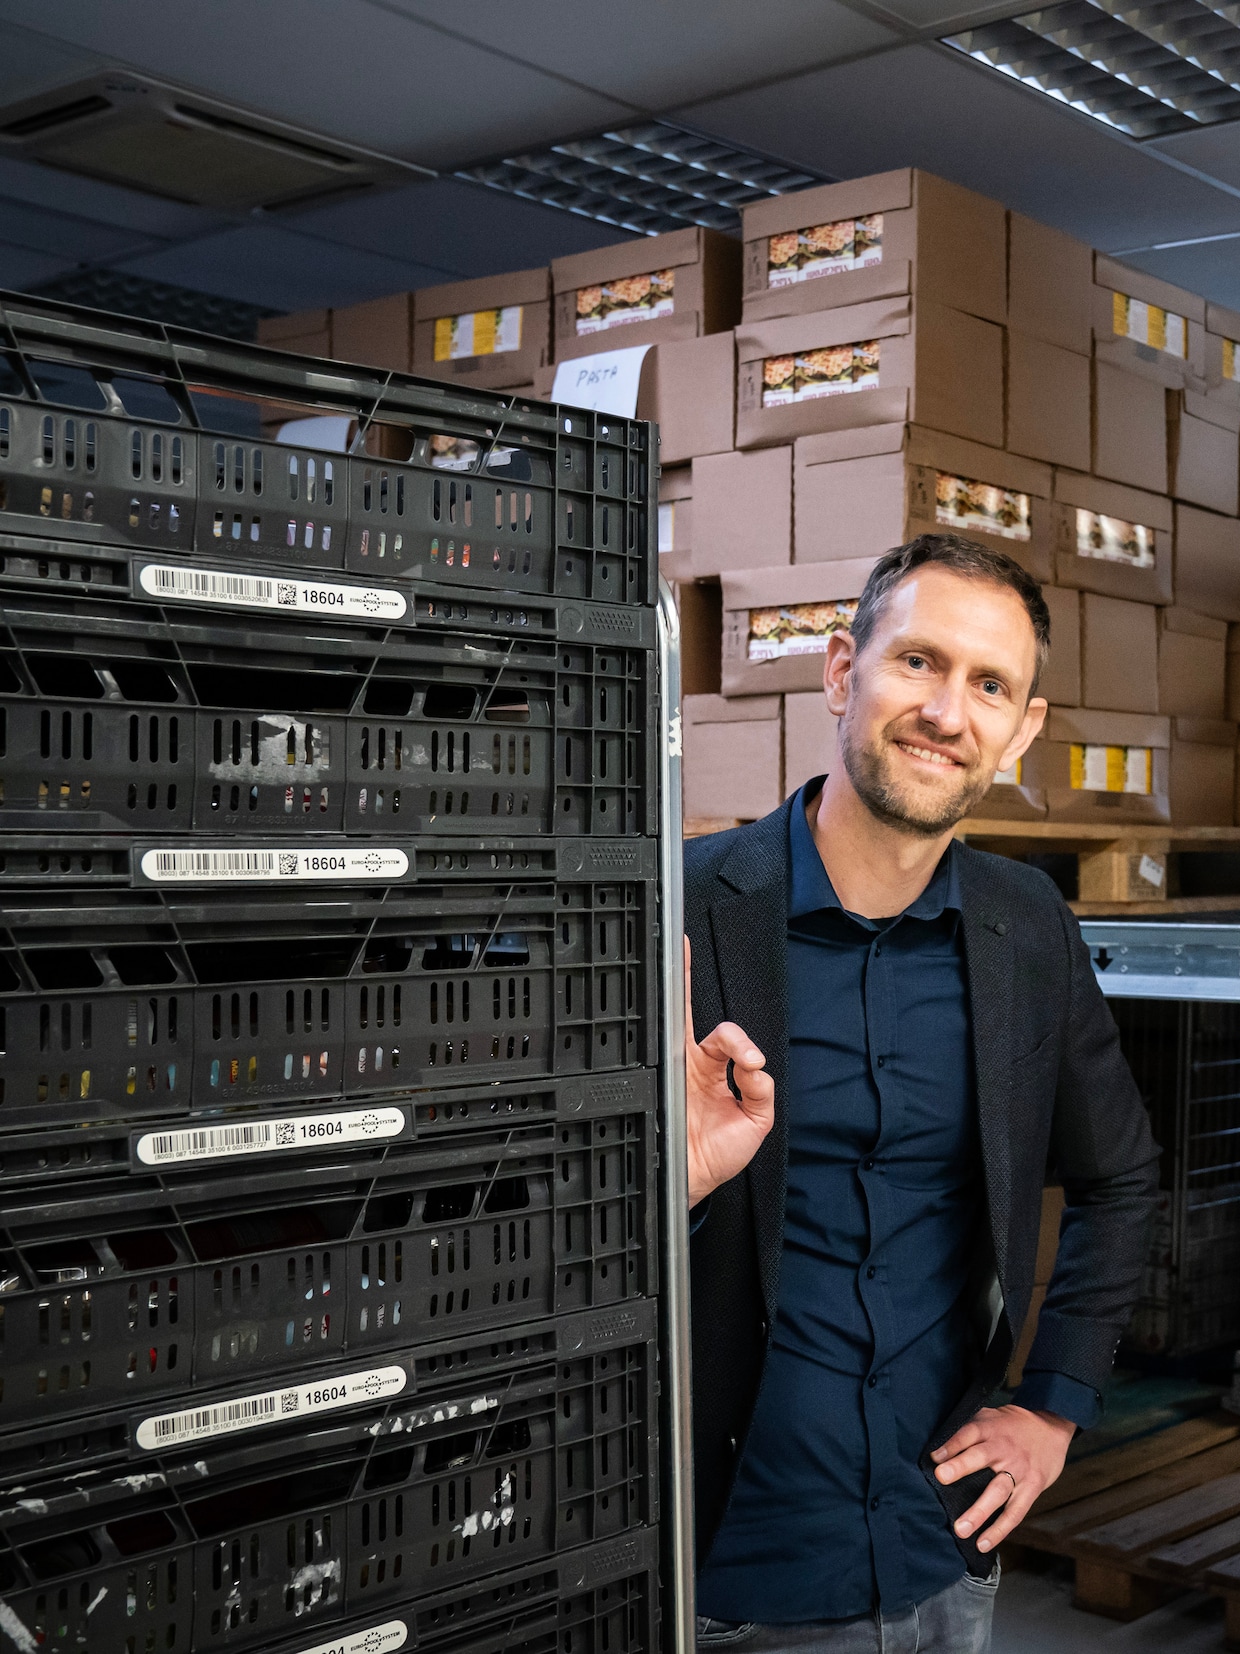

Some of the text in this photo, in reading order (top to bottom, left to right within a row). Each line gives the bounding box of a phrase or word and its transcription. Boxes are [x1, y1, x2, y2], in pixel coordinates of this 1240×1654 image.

[576, 366, 618, 387] PASTA
[156, 586, 176, 595] (8003)
[178, 588, 188, 596] 087
[302, 590, 344, 606] 18604
[304, 857, 346, 870] 18604
[300, 1121, 342, 1138] 18604
[154, 1152, 174, 1160] (8003)
[382, 1378, 399, 1386] SYSTEM
[306, 1384, 347, 1406] 18604
[156, 1435, 177, 1445] (8003)
[178, 1432, 190, 1440] 087
